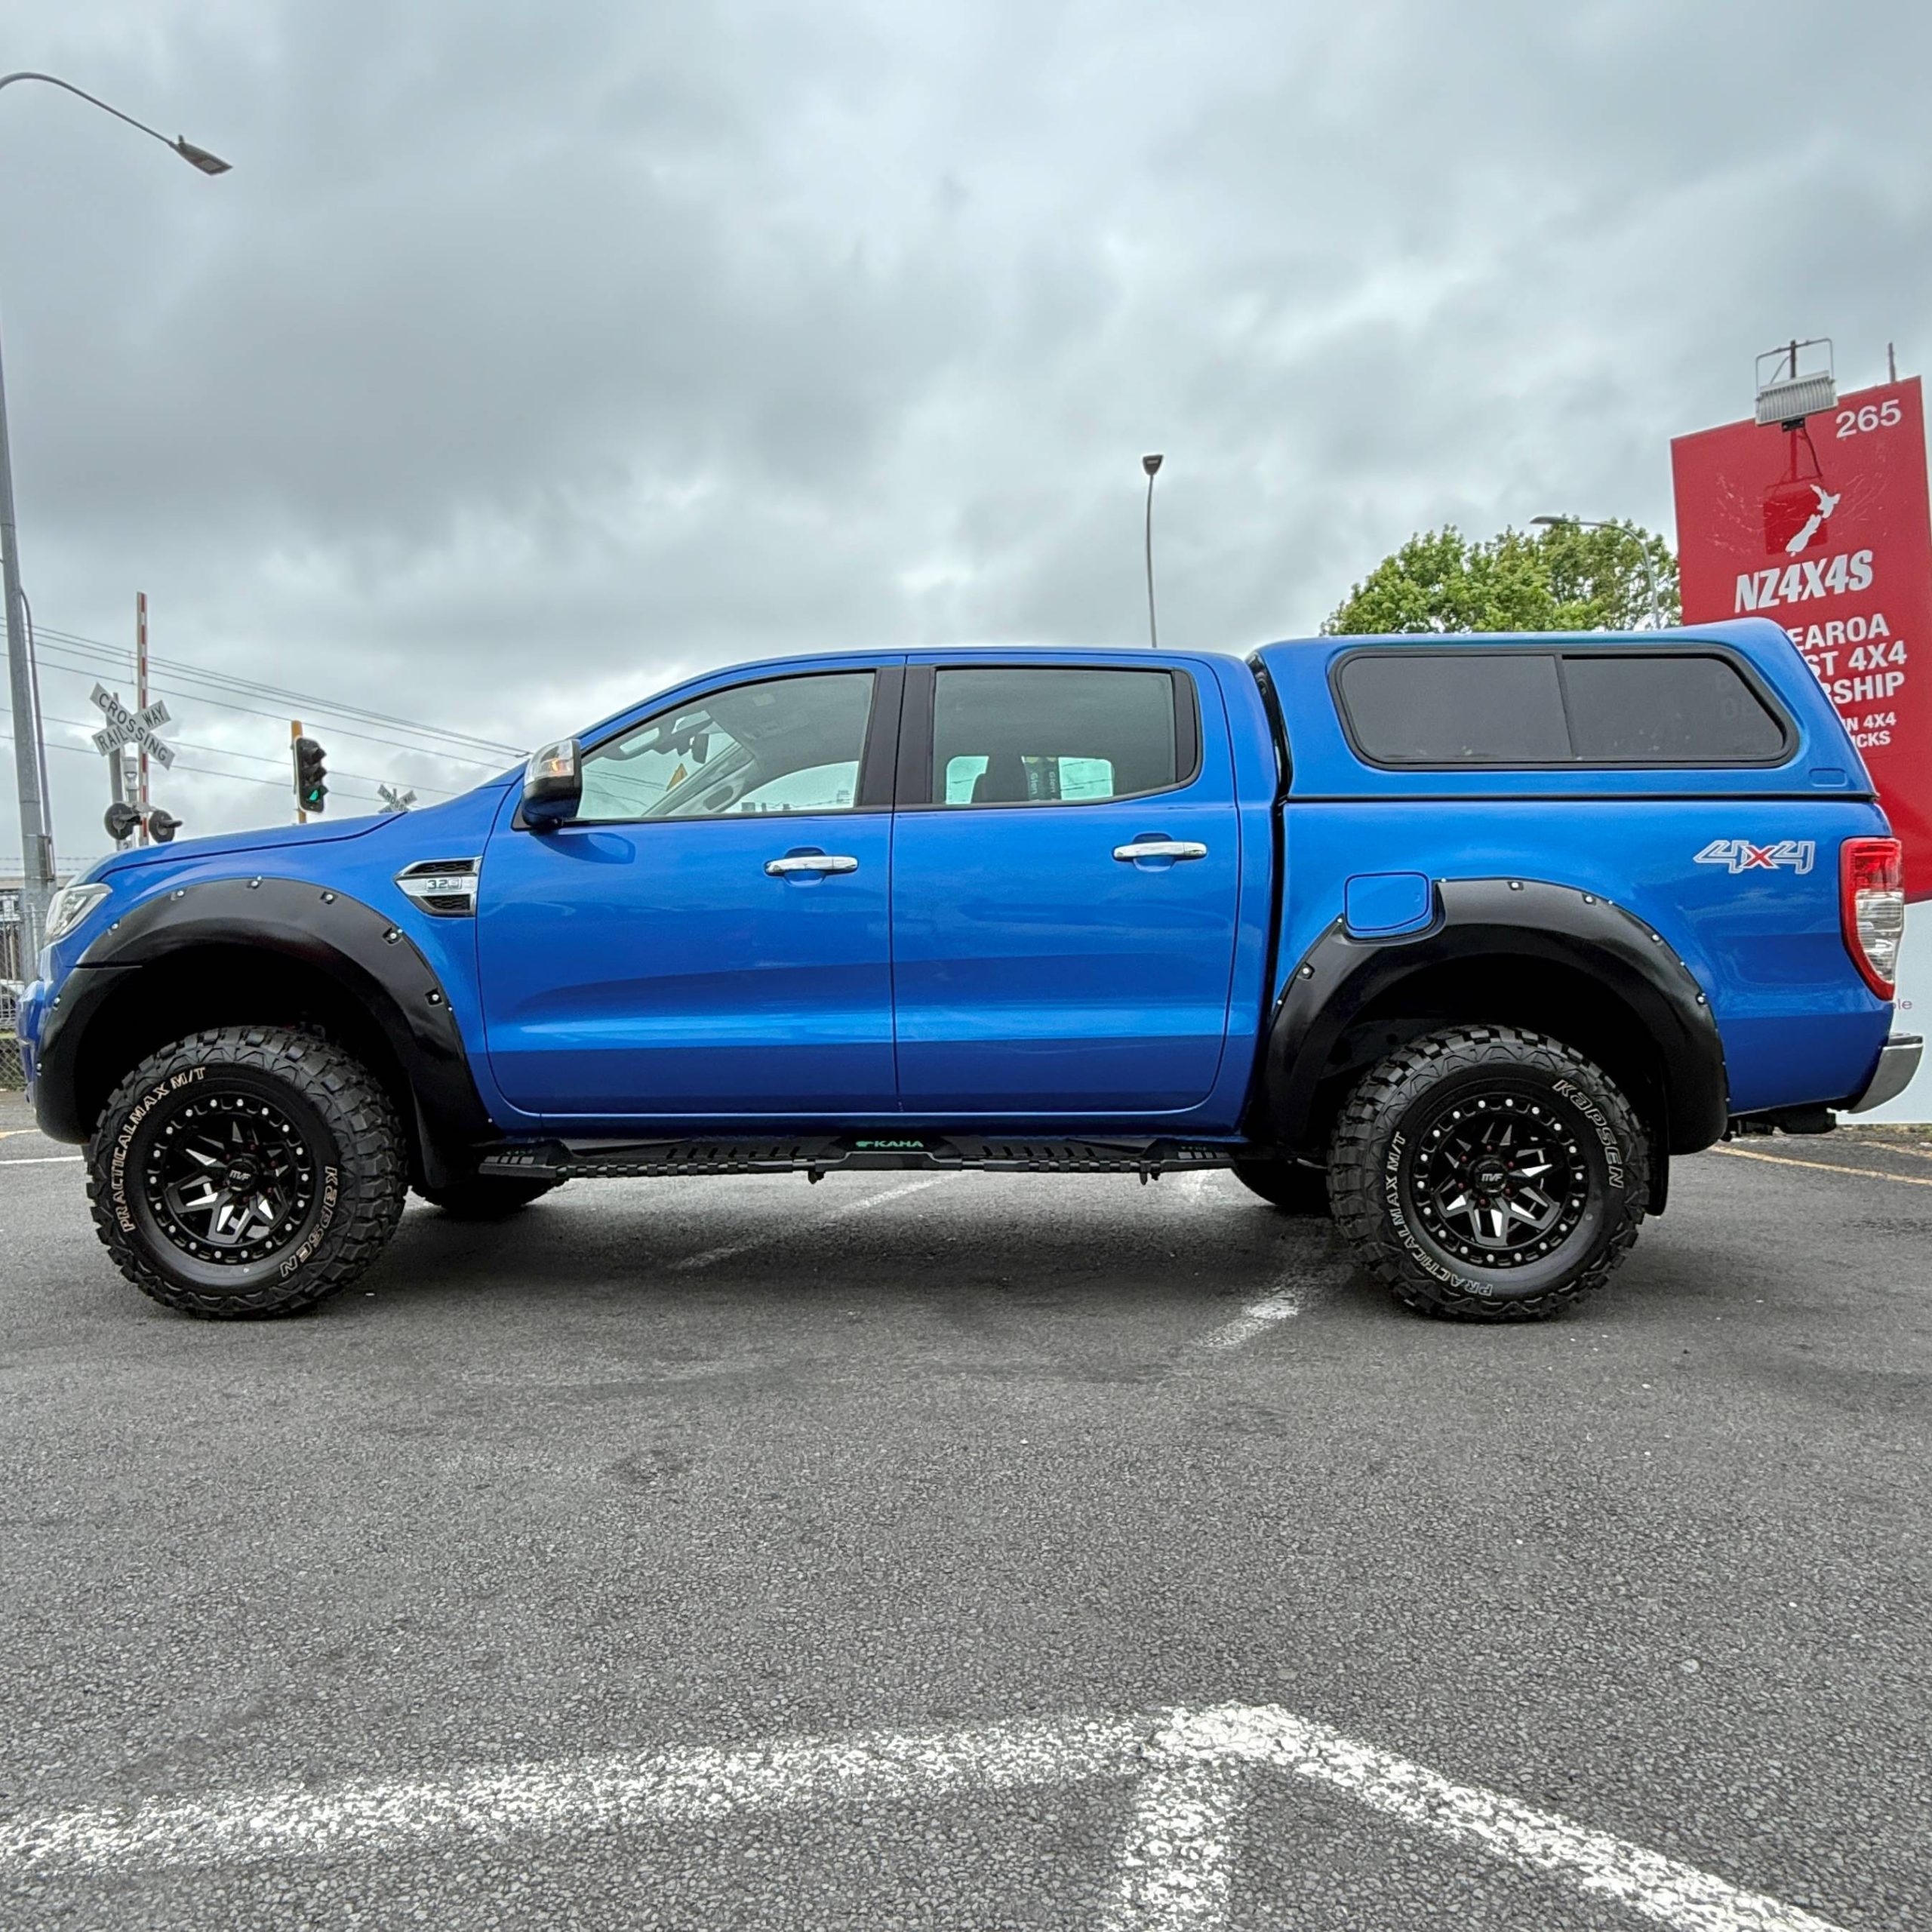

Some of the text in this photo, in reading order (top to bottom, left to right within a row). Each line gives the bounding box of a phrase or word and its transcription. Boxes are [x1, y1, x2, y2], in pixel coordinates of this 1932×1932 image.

[1835, 399, 1902, 439] 265
[1734, 549, 1874, 614] NZ4X4S
[1787, 613, 1890, 651] EAROA
[1804, 640, 1907, 677] ST 4X4
[97, 704, 165, 752] RAIL WAY
[99, 693, 168, 761] CROSSING
[1863, 711, 1897, 729] 4X4
[109, 1066, 206, 1233] PRACTICALMAX M/T
[1386, 1131, 1408, 1172] M/T
